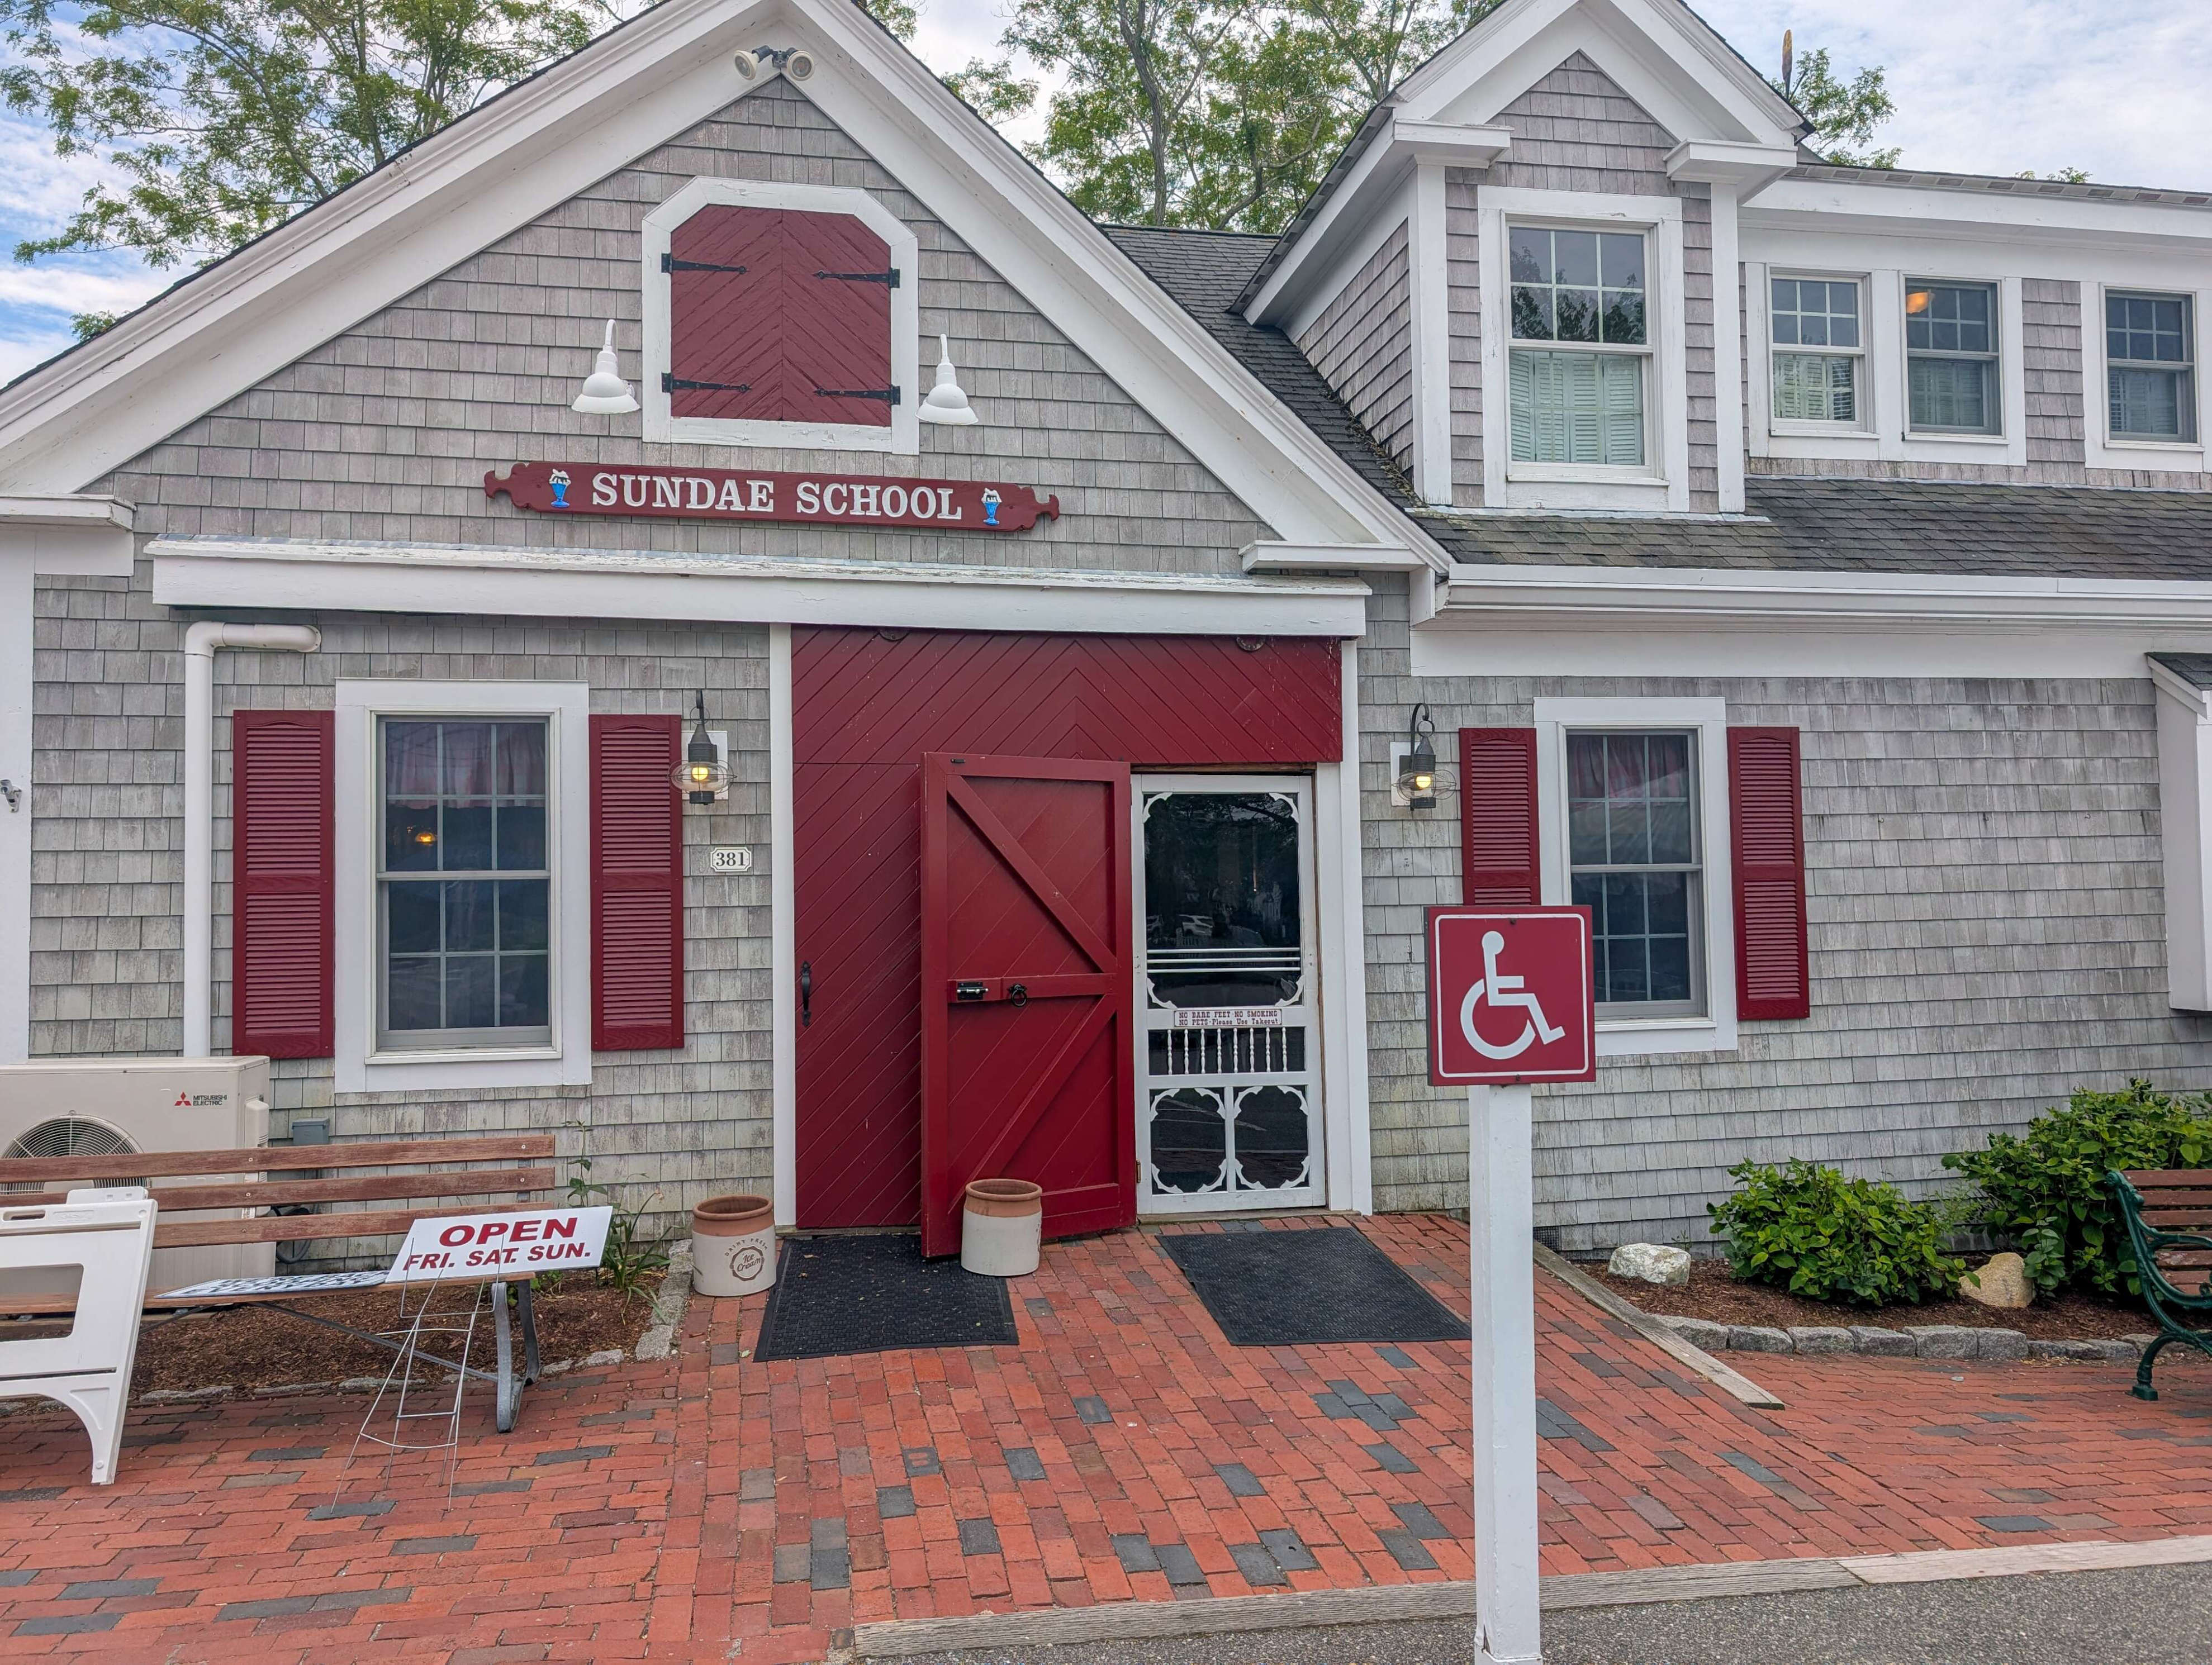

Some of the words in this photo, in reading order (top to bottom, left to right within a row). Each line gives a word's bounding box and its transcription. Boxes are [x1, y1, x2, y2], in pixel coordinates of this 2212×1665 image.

[592, 472, 774, 512] SUNDAE
[797, 482, 962, 520] SCHOOL
[716, 852, 746, 866] 381
[439, 1217, 578, 1247] OPEN
[402, 1253, 454, 1271] FRI.
[466, 1248, 519, 1267] SAT.
[527, 1243, 591, 1261] SUN.
[737, 1258, 761, 1272] Cream
[742, 1253, 755, 1263] Ice
